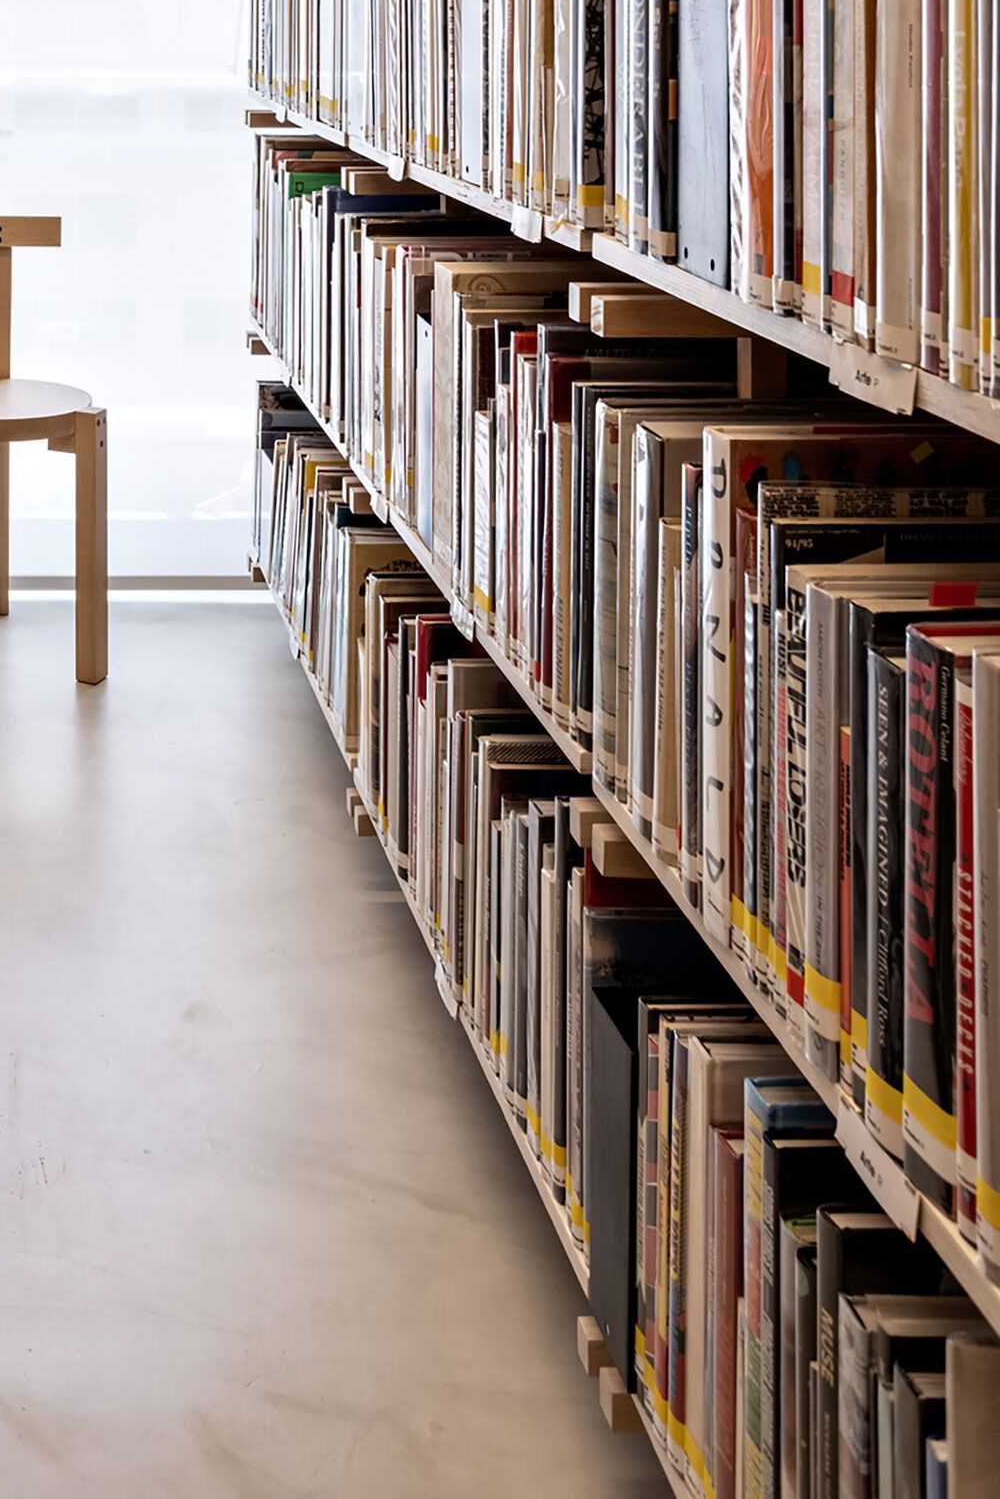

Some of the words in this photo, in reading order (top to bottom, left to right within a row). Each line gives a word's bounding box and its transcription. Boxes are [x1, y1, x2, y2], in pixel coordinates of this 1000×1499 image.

[808, 114, 820, 219] PALMA
[854, 369, 872, 387] Arte
[787, 586, 807, 754] BEAUTIFUL
[940, 665, 951, 721] Germano
[813, 705, 826, 748] ART
[877, 683, 889, 749] SEEN
[939, 722, 951, 763] Celant
[877, 754, 888, 769] &
[787, 760, 807, 888] LOSERS
[813, 770, 826, 887] RELIGION
[876, 775, 888, 906] IMAGINED
[907, 657, 938, 1026] ROTELLA
[957, 867, 973, 976] STACKED
[875, 928, 889, 999] Clifford
[877, 1005, 888, 1047] Ross
[957, 993, 973, 1076] DECKS
[859, 1151, 876, 1178] Arte
[820, 1306, 834, 1388] MUSE
